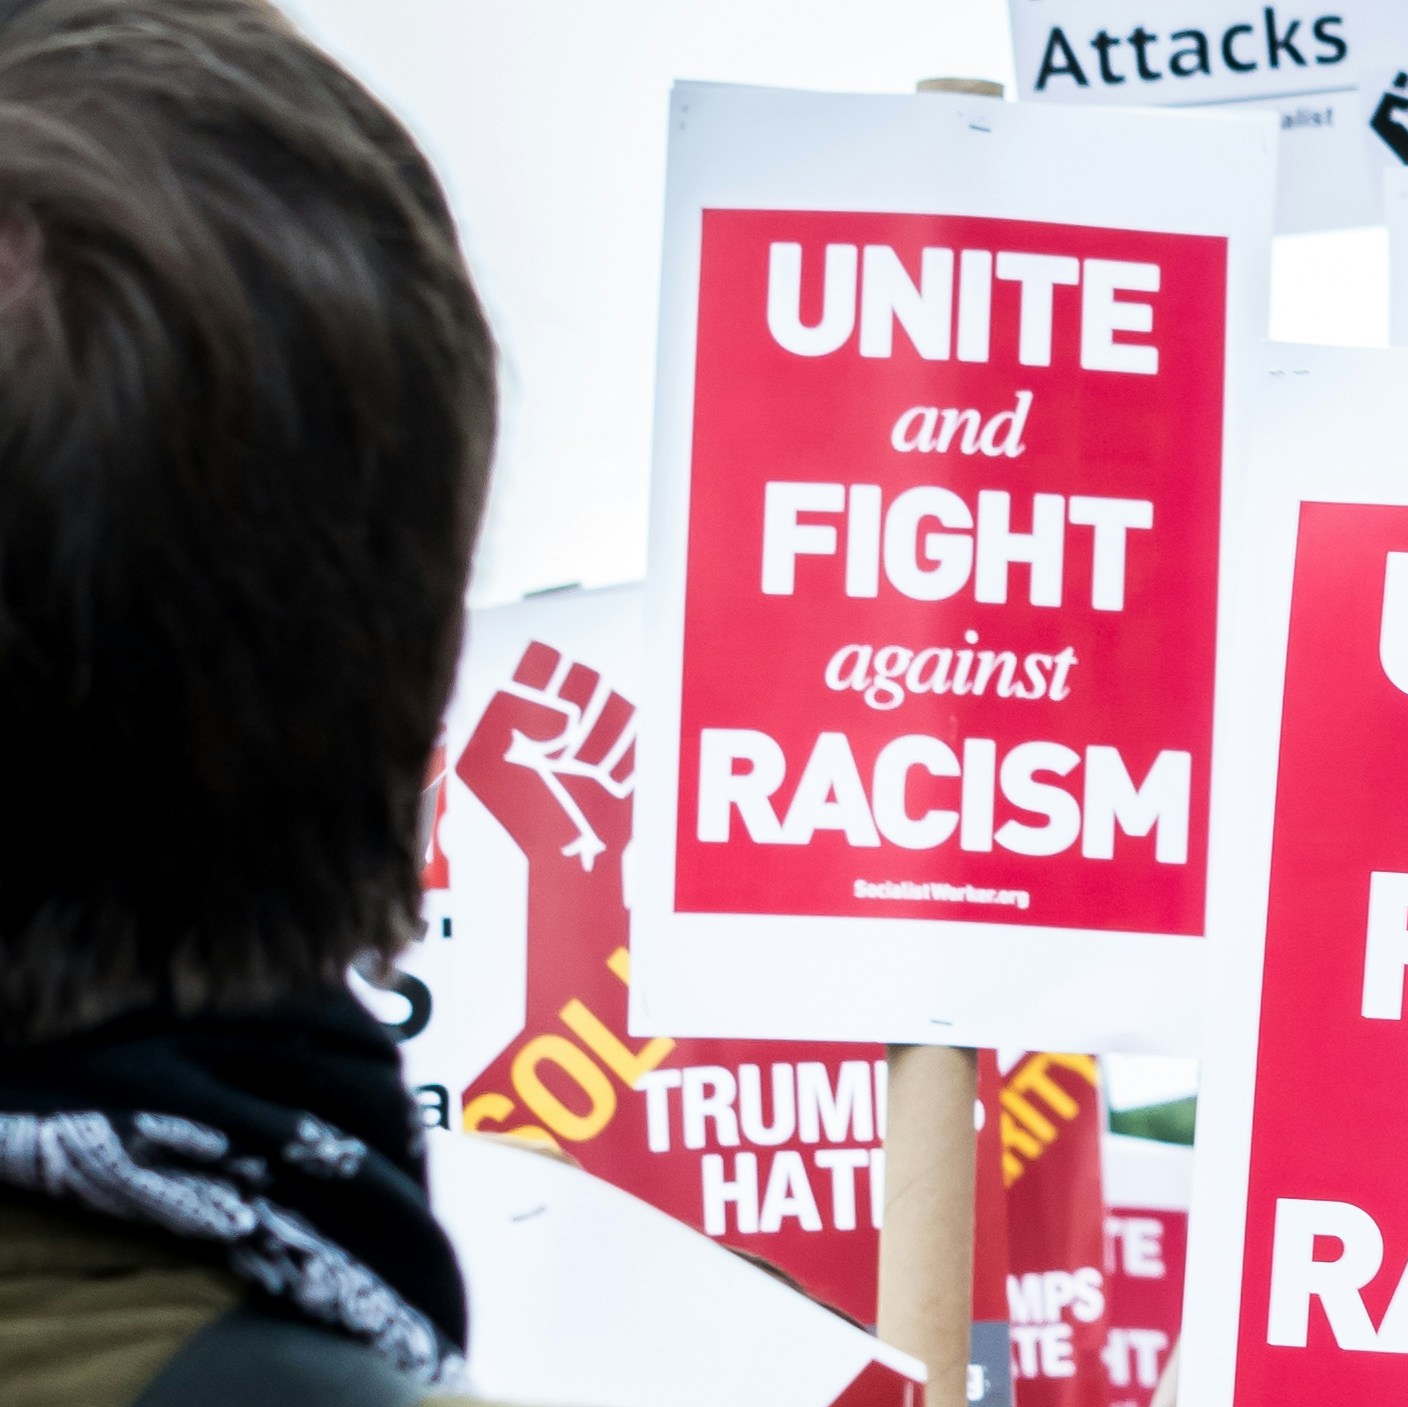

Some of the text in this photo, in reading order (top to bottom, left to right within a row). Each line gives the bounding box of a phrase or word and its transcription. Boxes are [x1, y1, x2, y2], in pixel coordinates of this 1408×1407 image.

[1034, 6, 1349, 92] Attacks
[767, 242, 1161, 375] UNITE
[890, 390, 1033, 458] and
[761, 480, 1154, 612] FIGHT
[824, 629, 1078, 710] against
[696, 728, 1192, 865] RACISM
